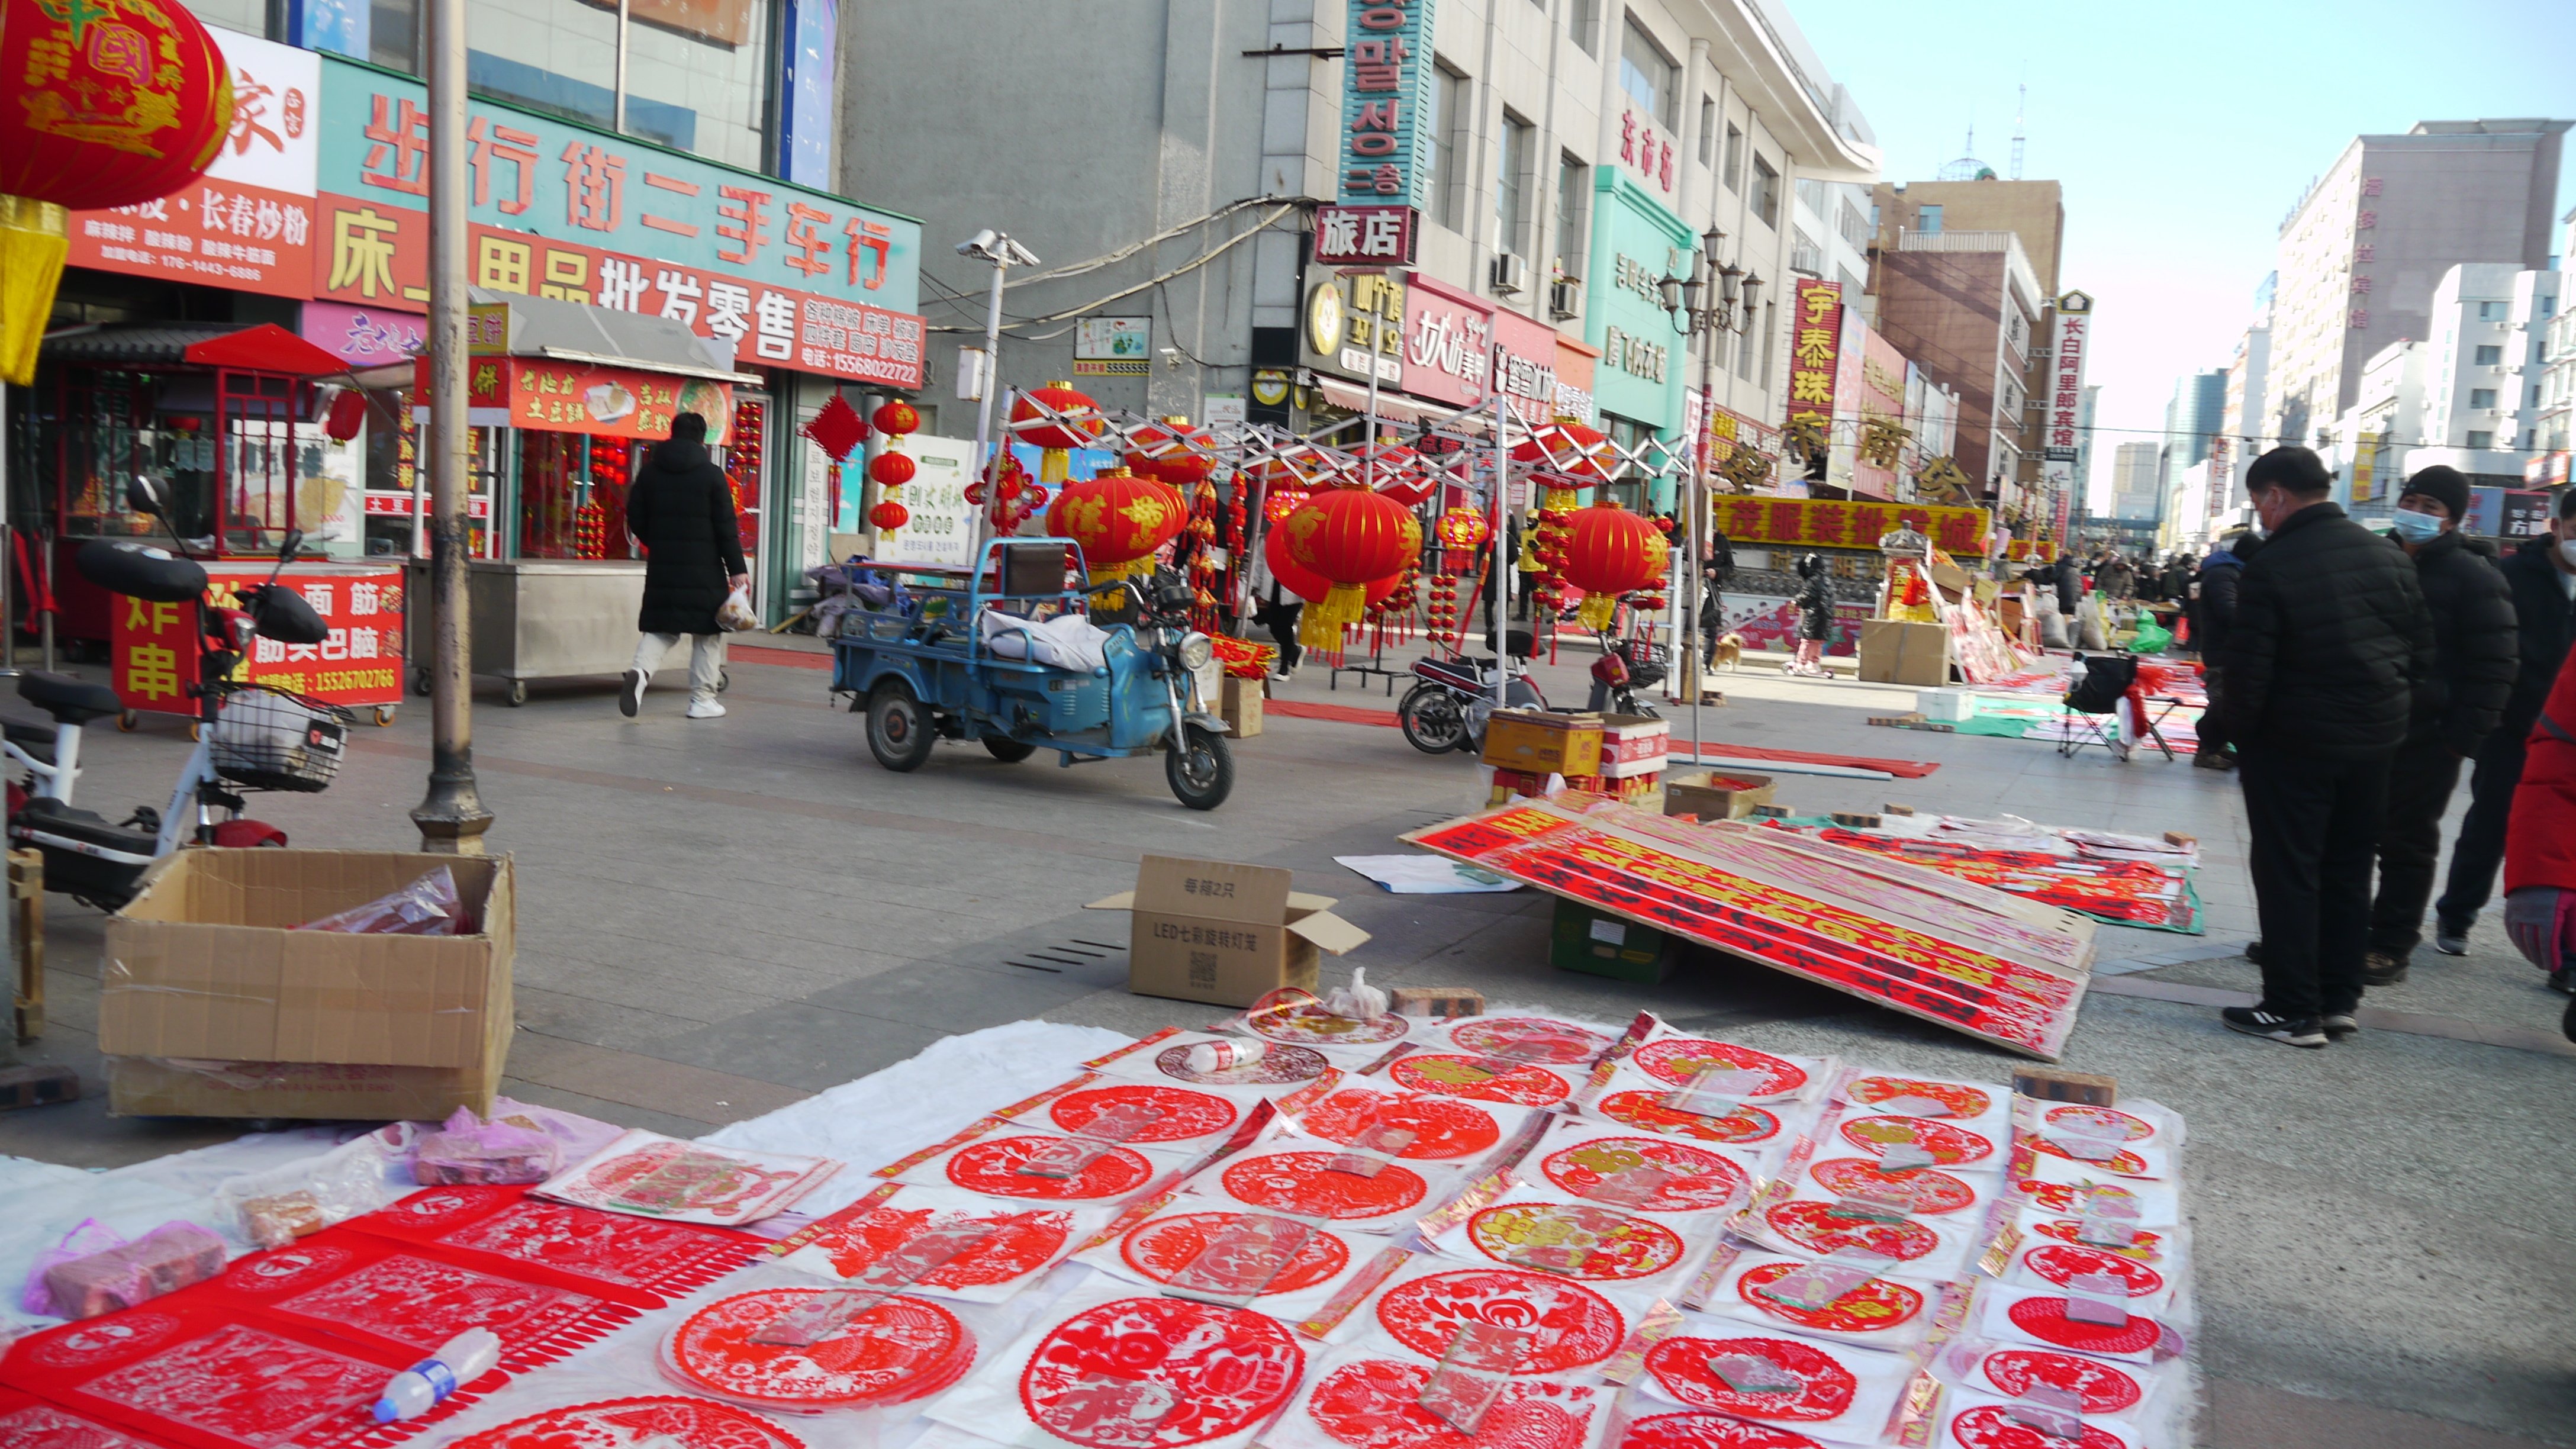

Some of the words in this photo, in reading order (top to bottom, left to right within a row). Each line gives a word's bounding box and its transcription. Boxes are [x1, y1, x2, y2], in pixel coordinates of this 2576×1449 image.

[361, 93, 891, 290] 步行街二手车行
[1320, 210, 1402, 256] 旅店
[802, 323, 846, 350] 四件套
[863, 311, 891, 336] 床单
[520, 369, 575, 395] 老地方
[637, 381, 672, 407] 吉林
[1184, 877, 1235, 899] 每箱2只
[1154, 922, 1258, 952] LED七彩旋转灯笼
